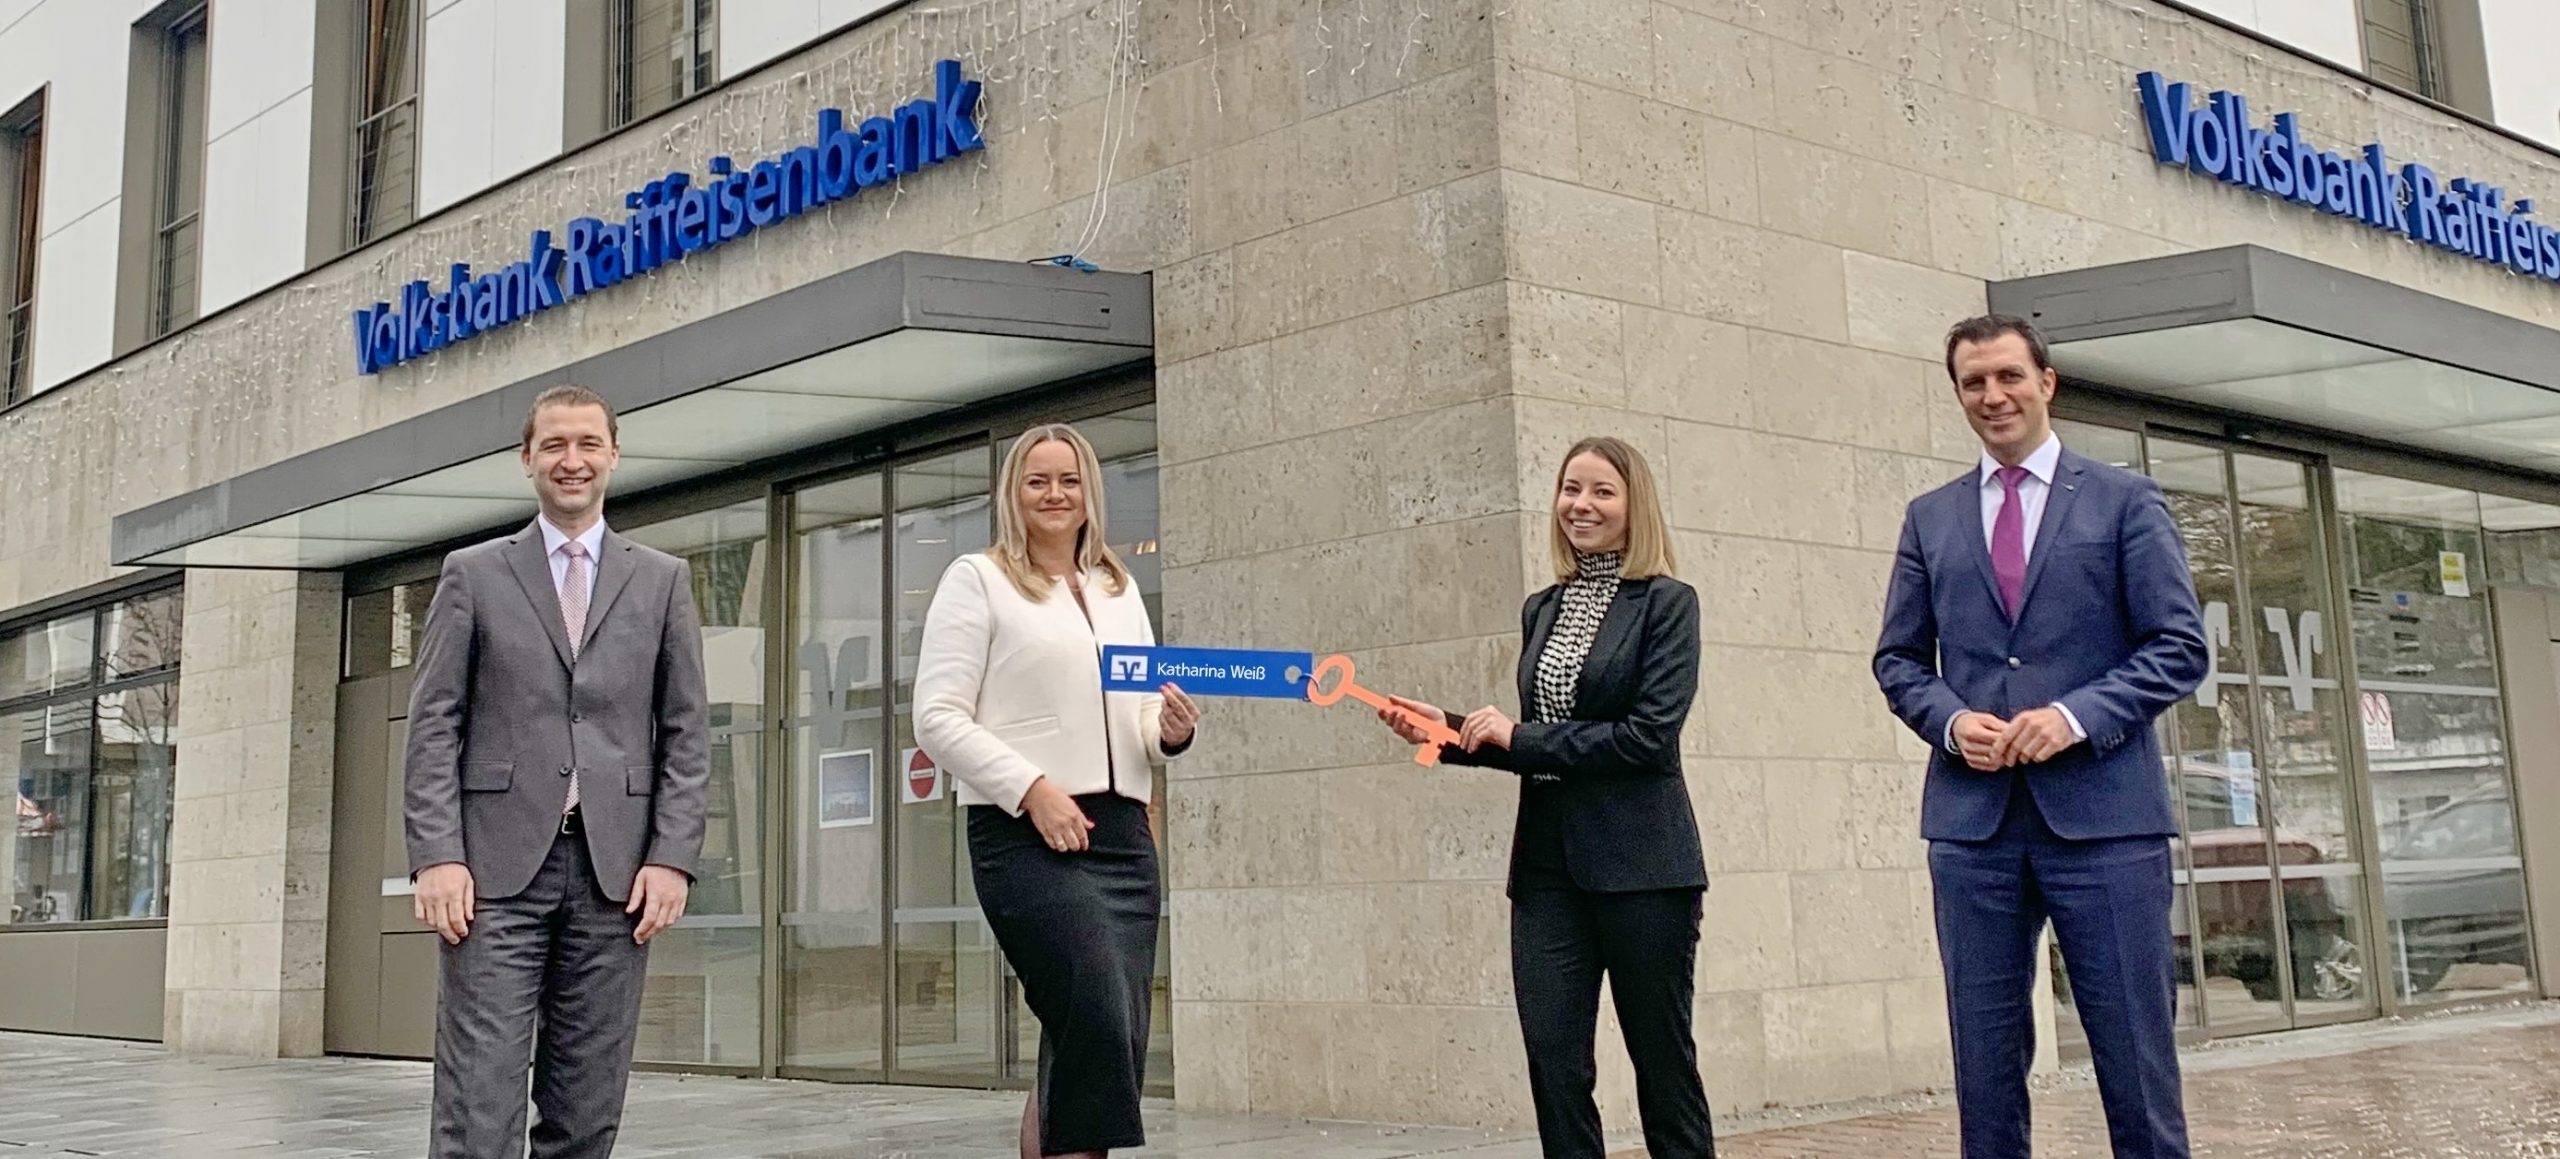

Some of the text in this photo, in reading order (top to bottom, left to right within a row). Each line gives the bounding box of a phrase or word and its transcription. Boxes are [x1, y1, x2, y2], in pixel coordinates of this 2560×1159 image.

[352, 60, 985, 376] Volksbank Raiffeisenbank
[2137, 71, 2560, 283] Volksbank Raiffeis
[1157, 662, 1266, 681] Katharina Weiß
